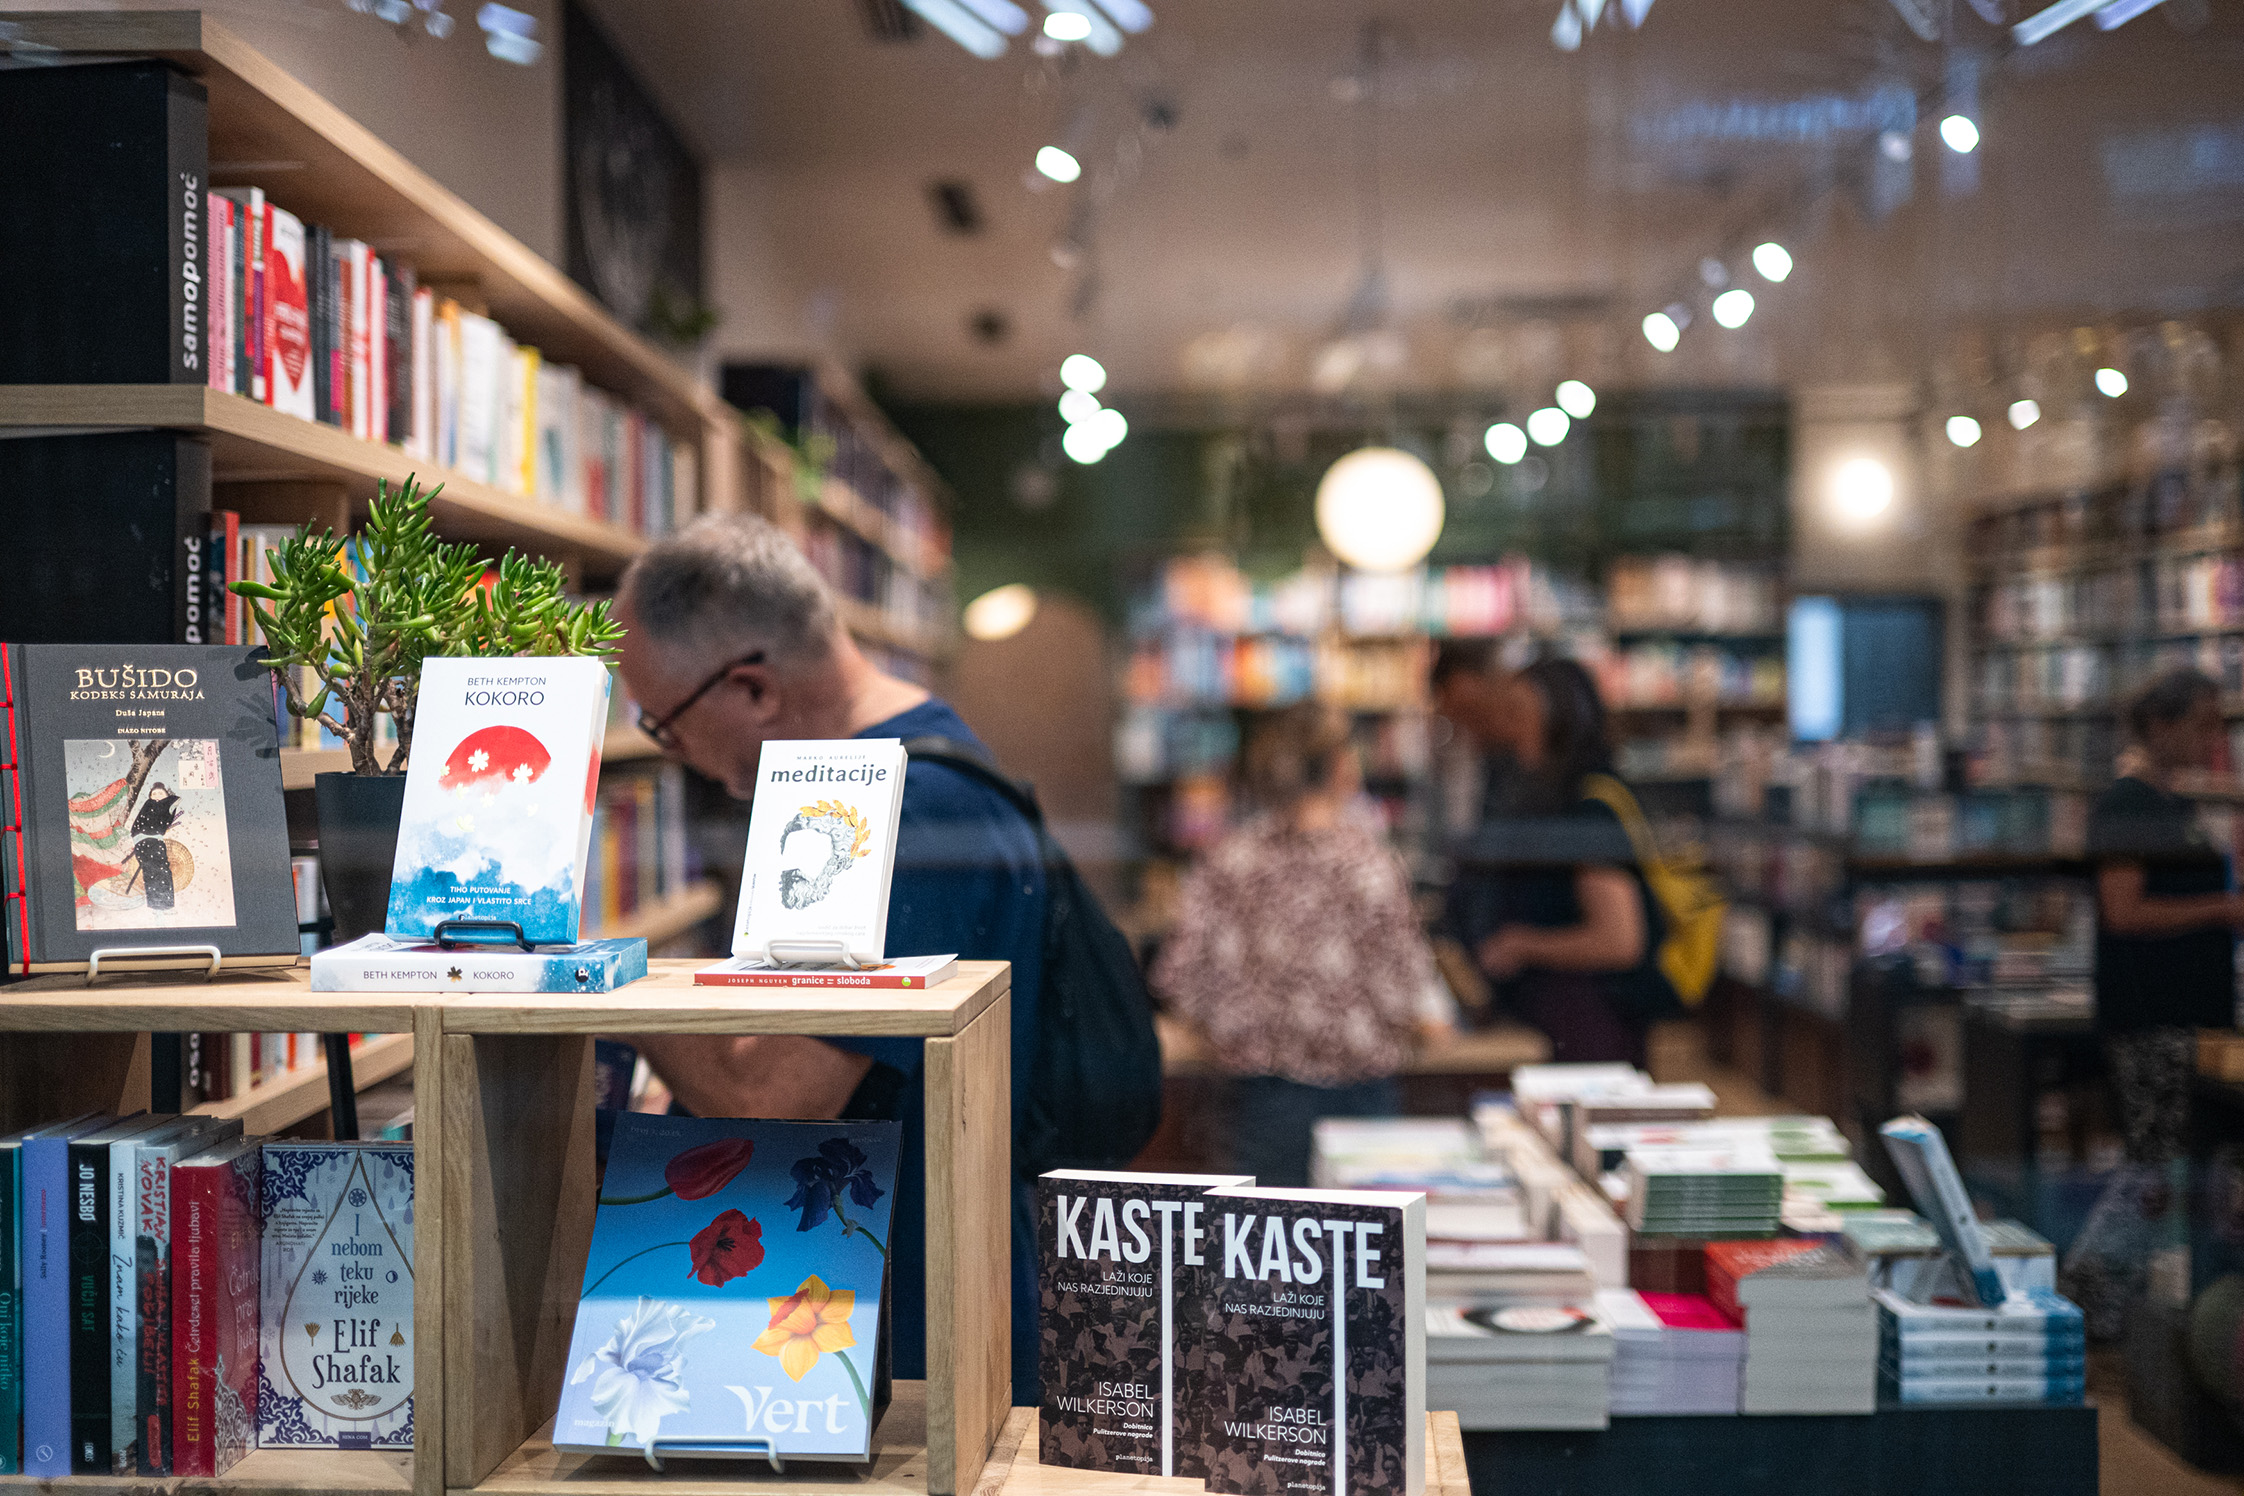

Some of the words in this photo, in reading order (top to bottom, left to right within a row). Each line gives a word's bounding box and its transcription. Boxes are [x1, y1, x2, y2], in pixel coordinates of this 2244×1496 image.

[180, 172, 201, 370] samopomoć
[75, 664, 197, 688] BUŠIDO
[467, 677, 493, 686] BETH
[497, 677, 546, 686] KEMPTON
[70, 690, 125, 700] KODEKS
[130, 690, 205, 701] SAMURAJA
[465, 691, 544, 706] KOKORO
[115, 709, 136, 717] Duša
[138, 709, 165, 718] Japana
[771, 764, 887, 786] meditacije
[426, 896, 446, 904] KROZ
[448, 896, 470, 904] JAPAN
[477, 897, 512, 905] VLASTITO
[450, 886, 468, 894] TIHO
[470, 886, 511, 894] PUTOVANJE
[363, 971, 388, 979] BETH
[391, 971, 437, 979] KEMPTON
[473, 971, 515, 980] KOKORO
[792, 976, 824, 985] granice
[837, 976, 871, 985] sloboda
[79, 1164, 95, 1180] JO
[117, 1173, 125, 1209] KRISTINA
[141, 1160, 153, 1232] NOVAK
[154, 1157, 166, 1243] KRISTIAN
[79, 1183, 96, 1222] NESBØ
[117, 1210, 126, 1240] KUZMIĆ
[188, 1201, 202, 1243] ljubavi
[355, 1214, 360, 1236] I
[1057, 1195, 1204, 1266] KASTE
[331, 1237, 383, 1256] nebom
[1224, 1213, 1385, 1289] KASTE
[111, 1254, 132, 1299] Znam
[188, 1248, 202, 1291] pravila
[340, 1263, 373, 1282] teku
[1102, 1270, 1125, 1282] LAŽI
[1128, 1272, 1152, 1284] KOJE
[334, 1285, 379, 1309] rijeke
[1058, 1282, 1079, 1292] NAS
[1081, 1284, 1153, 1297] RAZJEDINJUJU
[1273, 1291, 1297, 1303] LAŽI
[1299, 1294, 1325, 1306] KOJE
[81, 1308, 95, 1332] SAT
[1225, 1303, 1248, 1314] NAS
[1250, 1305, 1325, 1319] RAZJEDINJUJU
[116, 1305, 130, 1345] kako
[333, 1318, 380, 1354] Elif
[312, 1354, 400, 1389] Shafak
[187, 1358, 200, 1410] Shafak
[1099, 1381, 1154, 1400] ISABEL
[724, 1385, 850, 1434] Vert
[1056, 1395, 1154, 1418] WILKERSON
[1269, 1406, 1327, 1426] ISABEL
[187, 1417, 200, 1442] Elif
[574, 1418, 615, 1429] magazin
[1093, 1428, 1126, 1437] Pulitzerove
[1127, 1430, 1153, 1439] nagrade
[1123, 1423, 1153, 1431] Dobitnica
[1224, 1421, 1326, 1445] WILKERSON
[1115, 1453, 1153, 1463] planetopija
[1264, 1454, 1298, 1464] Pulitzerove
[1299, 1458, 1326, 1467] nagrade
[1295, 1449, 1326, 1458] Dobitnica
[1287, 1481, 1326, 1491] planetopija
